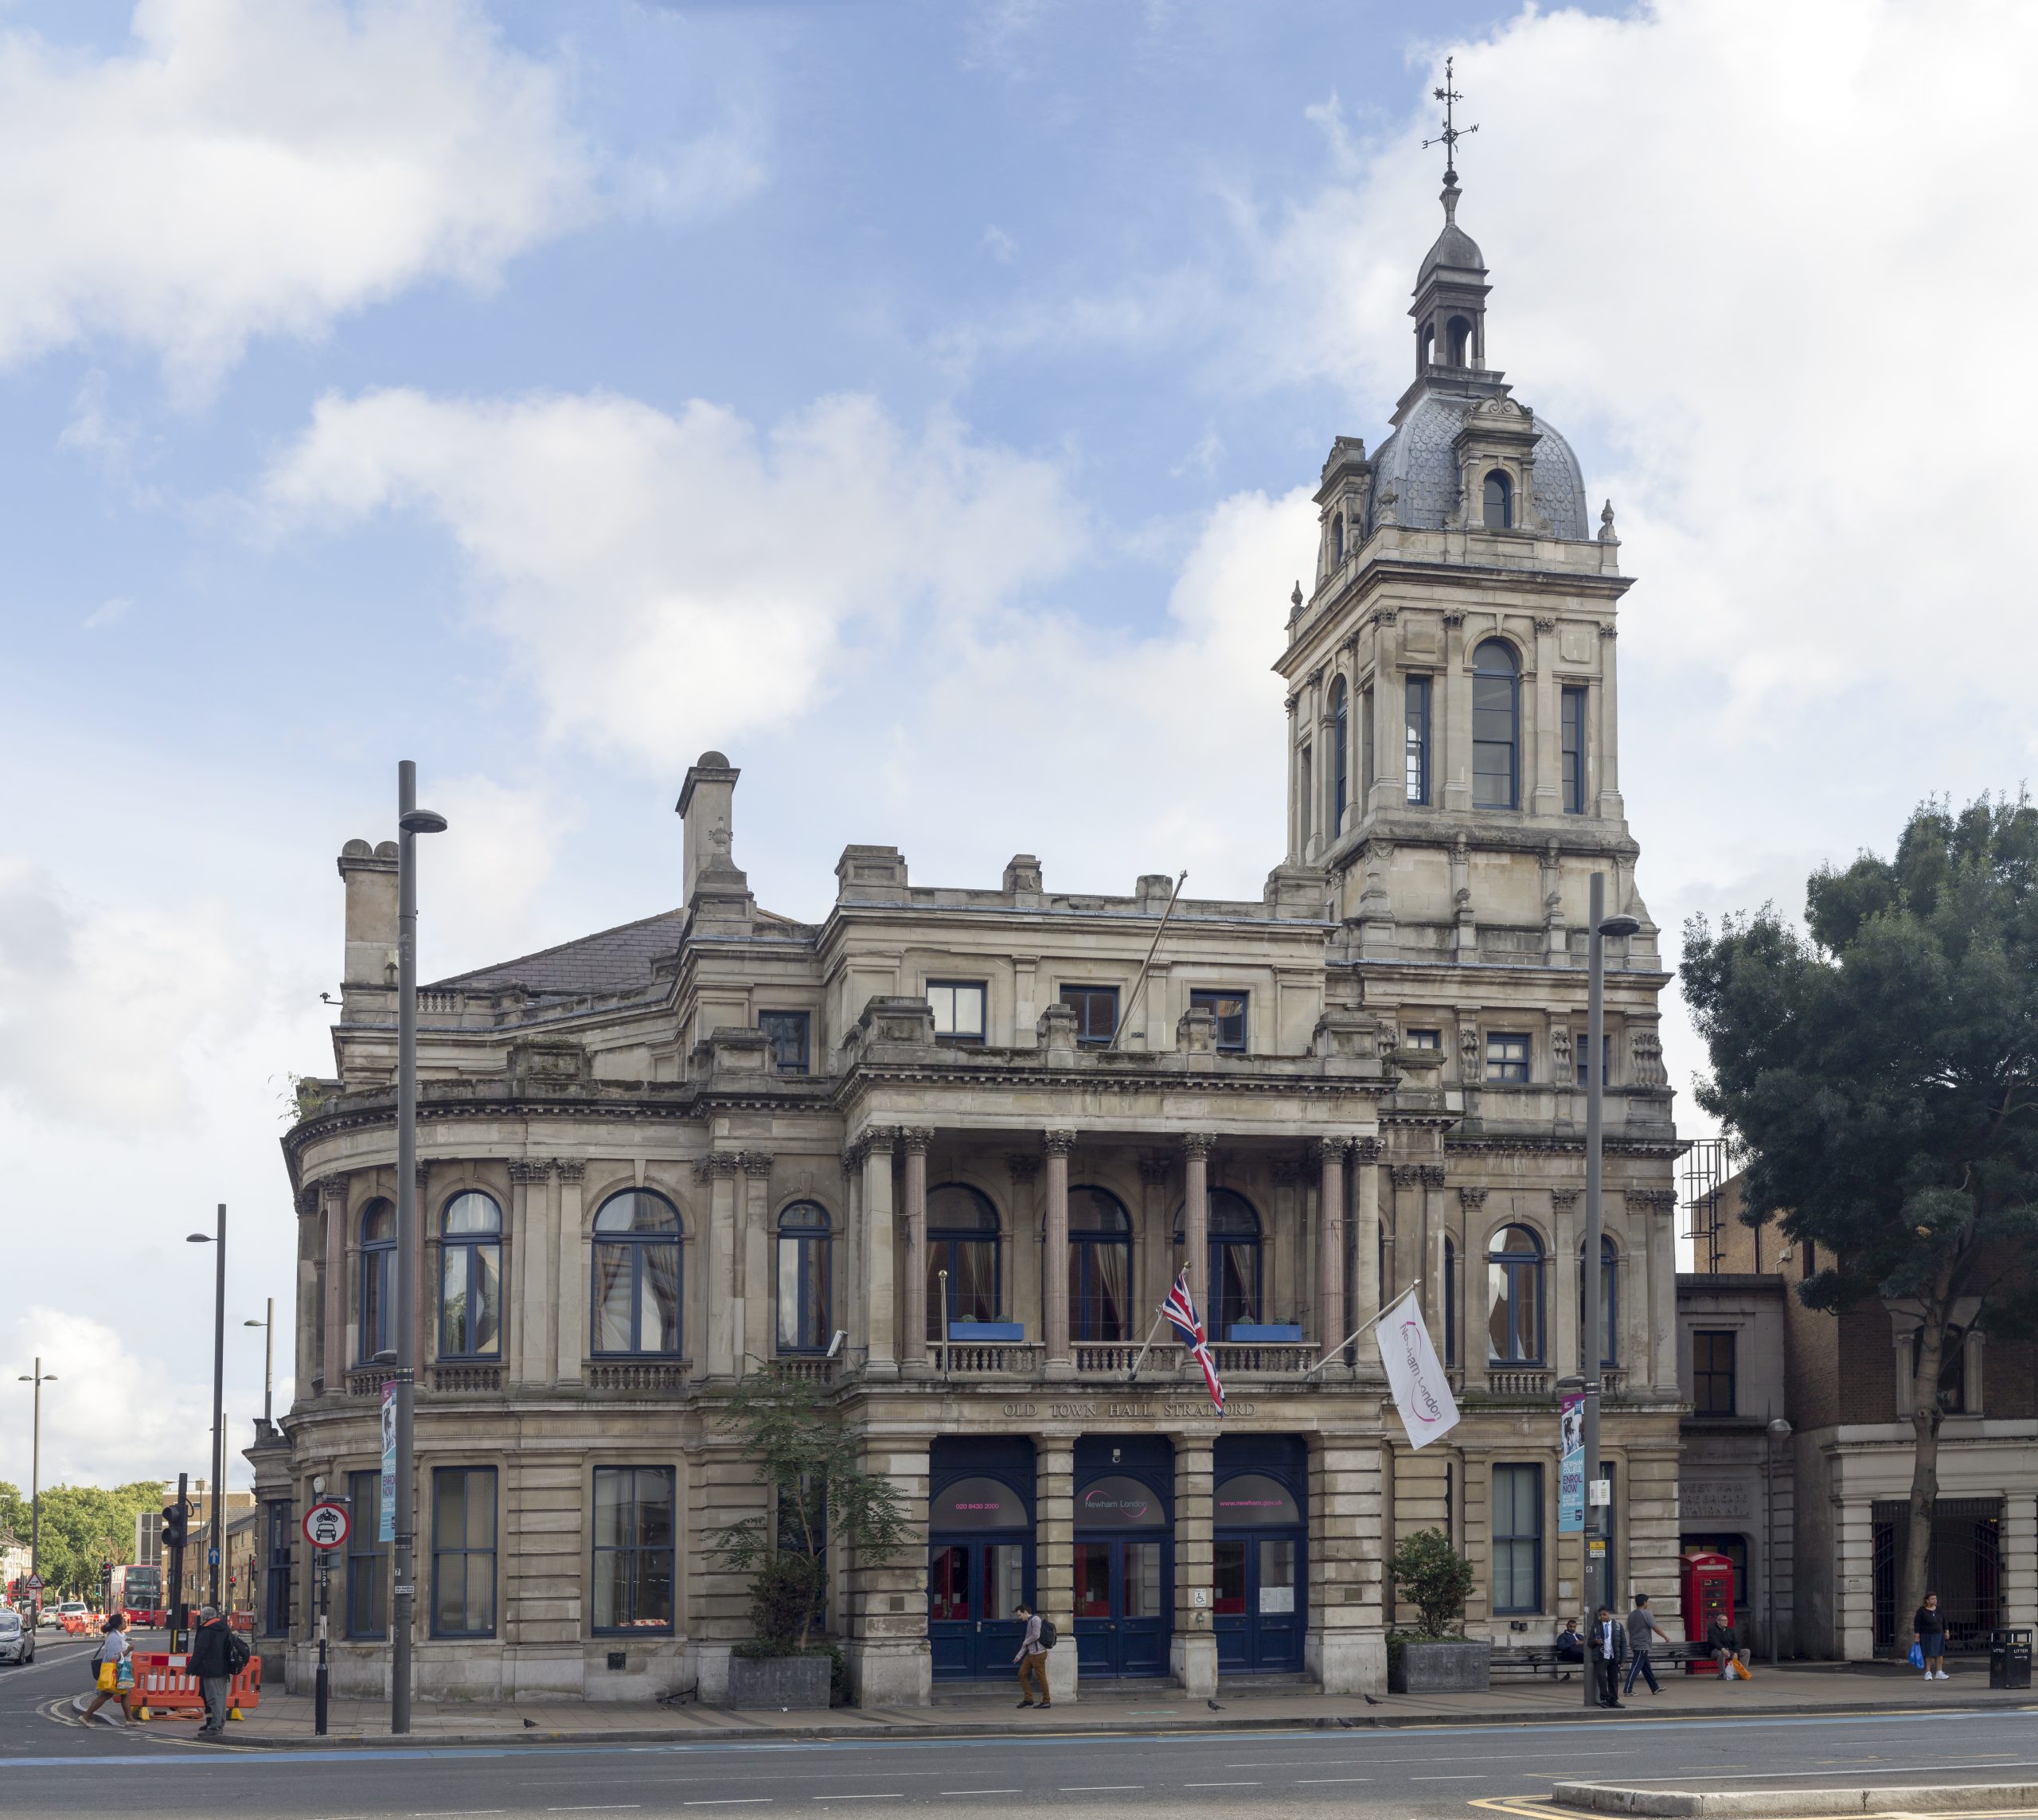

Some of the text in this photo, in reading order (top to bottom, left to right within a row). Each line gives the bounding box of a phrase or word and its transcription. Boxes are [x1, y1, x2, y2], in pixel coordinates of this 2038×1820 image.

[1470, 123, 1479, 133] W
[1400, 1322, 1420, 1377] Neham
[1004, 1404, 1037, 1416] OLD
[1050, 1404, 1097, 1416] TOWN
[1165, 1404, 1256, 1416] STRATORD
[1563, 1459, 1583, 1468] NEWHAM
[382, 1475, 396, 1486] ENRO
[1563, 1474, 1583, 1485] ENROL
[1563, 1483, 1578, 1494] NOW
[1679, 1483, 1712, 1493] WEST
